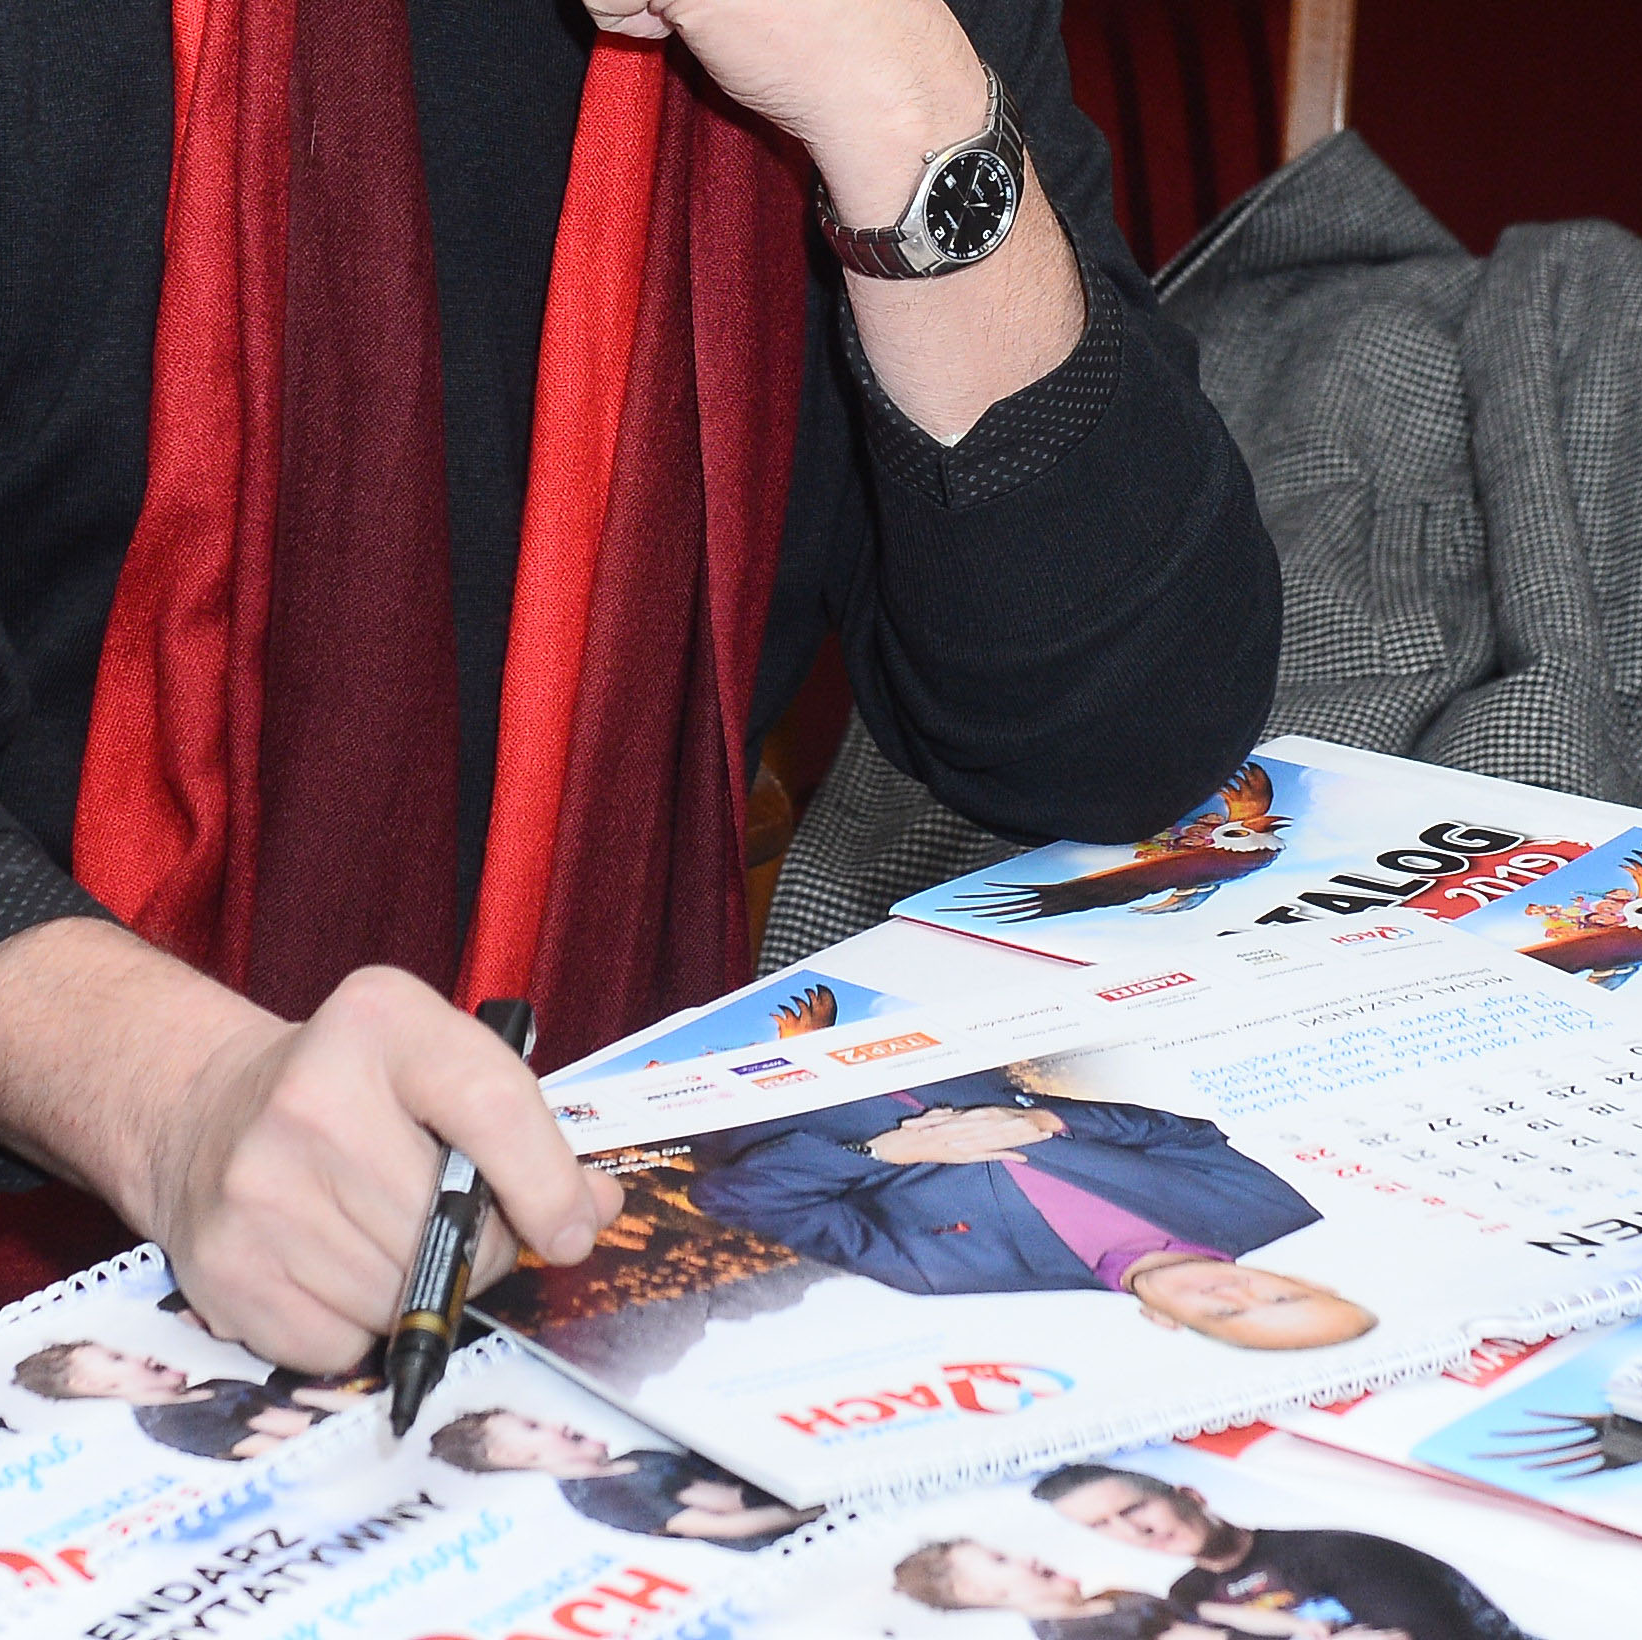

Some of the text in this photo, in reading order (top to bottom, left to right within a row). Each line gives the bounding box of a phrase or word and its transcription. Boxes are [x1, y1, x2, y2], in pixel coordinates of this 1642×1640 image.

[1253, 821, 1528, 927] TALOG
[1104, 974, 1188, 1000] MARTEL
[1546, 1085, 1587, 1099] 25
[1483, 1100, 1525, 1115] 26
[1587, 1102, 1625, 1116] 18
[1427, 1117, 1462, 1132] 27
[1526, 1118, 1563, 1131] 19
[1456, 1134, 1498, 1148] 20
[1570, 1136, 1600, 1147] 12
[1501, 1151, 1538, 1164] 13
[1336, 1164, 1366, 1178] 22
[84, 1526, 304, 1640] ENDARZ
